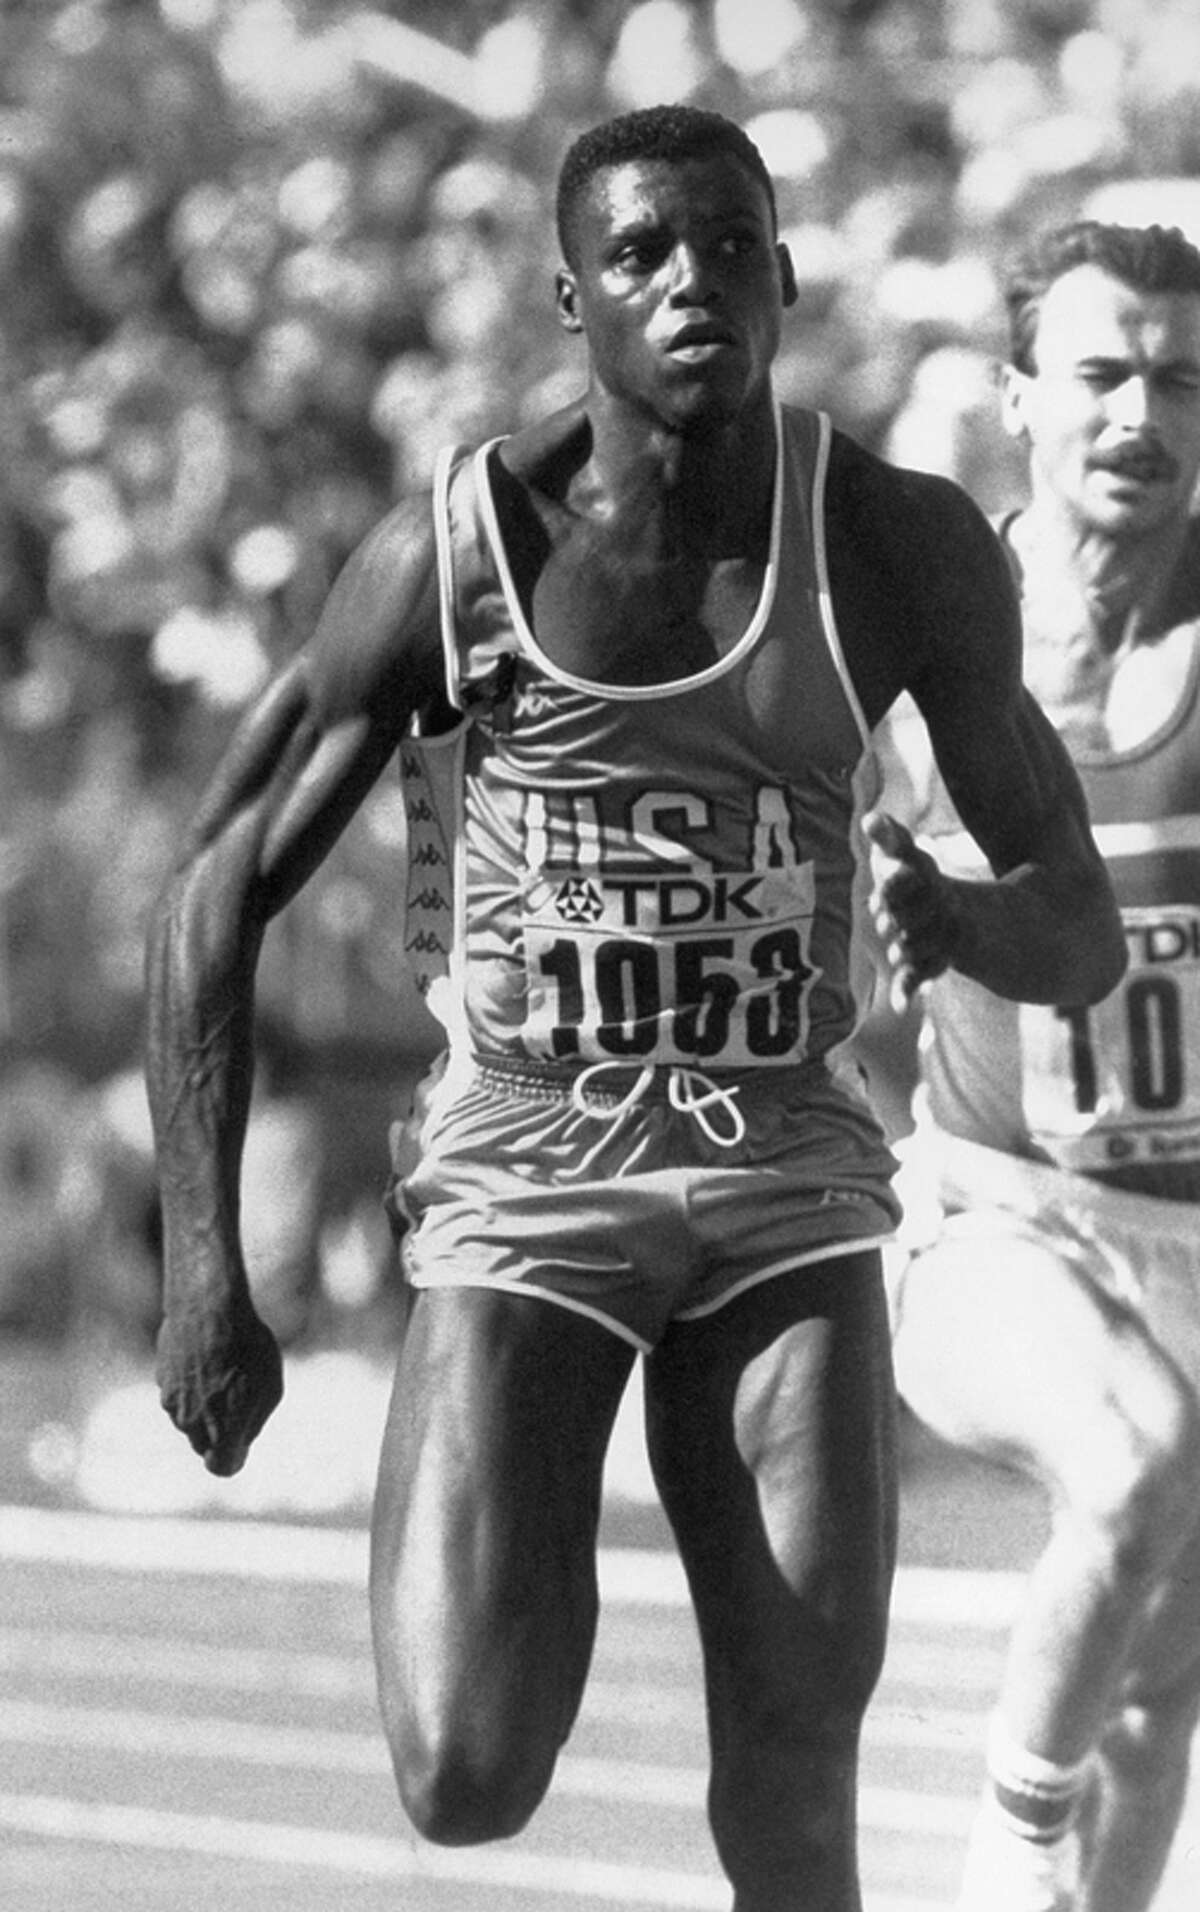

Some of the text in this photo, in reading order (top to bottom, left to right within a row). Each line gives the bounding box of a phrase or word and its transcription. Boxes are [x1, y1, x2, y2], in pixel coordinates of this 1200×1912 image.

[524, 786, 799, 880] USA
[602, 877, 766, 926] TDK
[539, 928, 813, 1058] 1053
